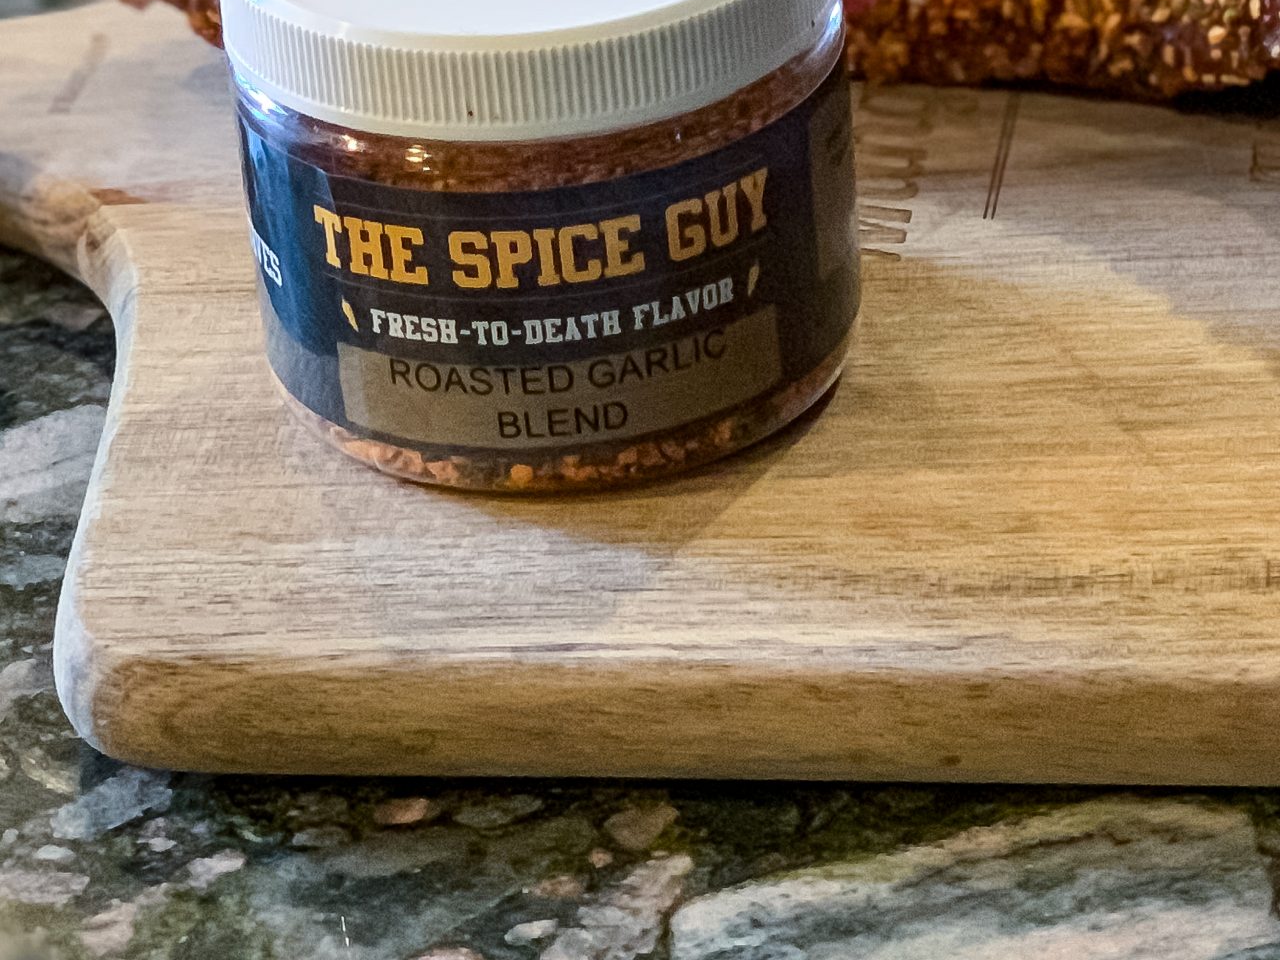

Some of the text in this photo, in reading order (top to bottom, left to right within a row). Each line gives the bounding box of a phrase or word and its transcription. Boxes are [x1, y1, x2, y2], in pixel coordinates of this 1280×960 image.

[313, 204, 429, 285] THE
[448, 214, 646, 289] SPICE
[664, 167, 768, 262] GUY
[369, 276, 734, 346] FRESH-TO-DEATH FLAVOR
[388, 327, 727, 396] ROASTED GARLIC
[497, 400, 629, 439] BLEND
